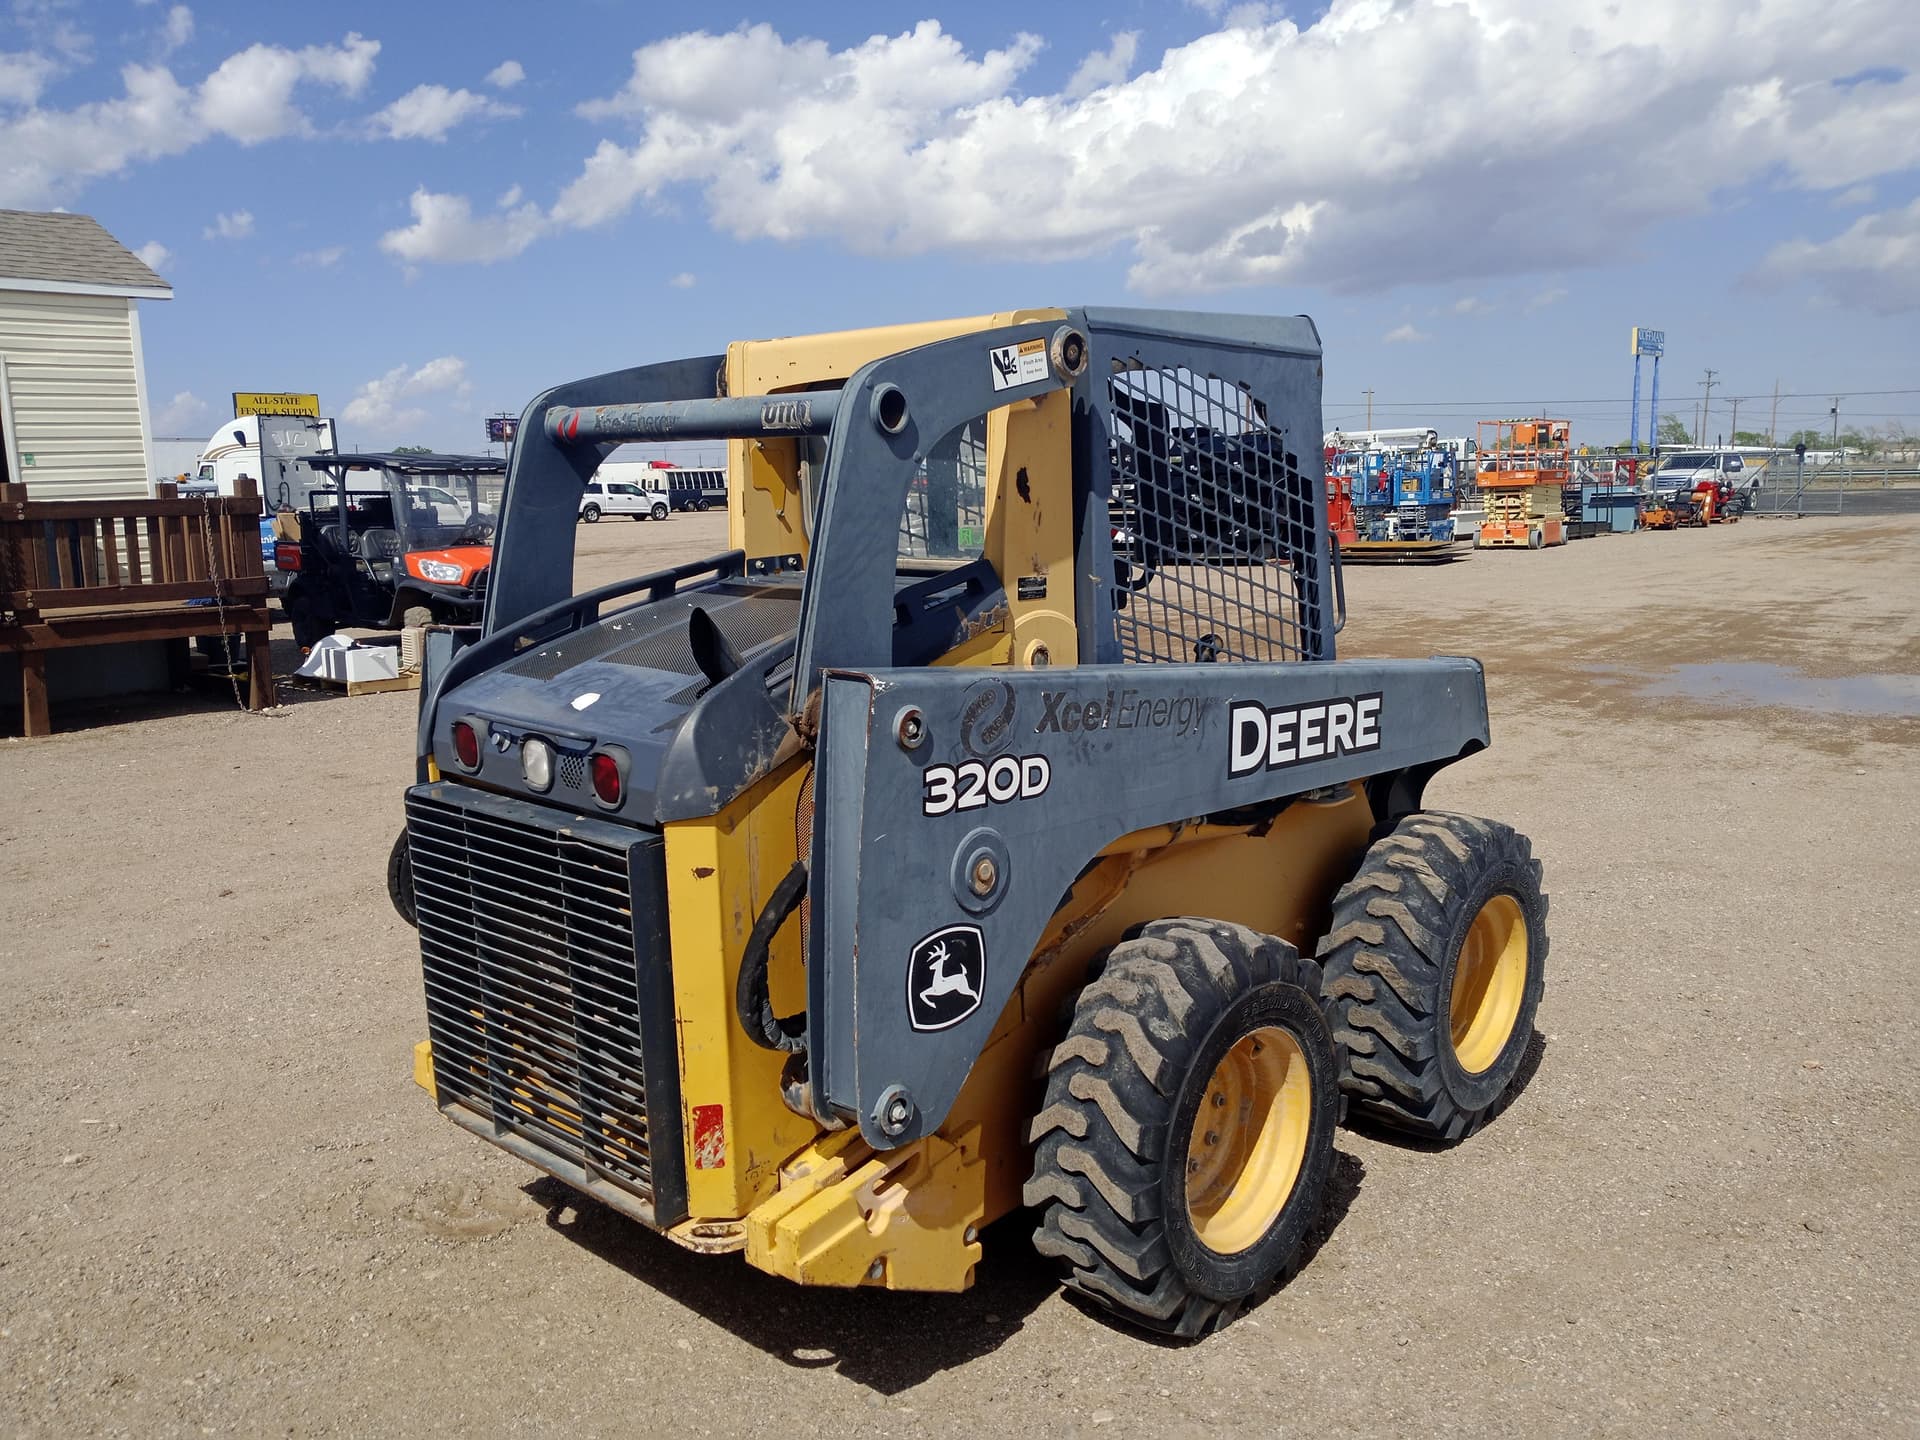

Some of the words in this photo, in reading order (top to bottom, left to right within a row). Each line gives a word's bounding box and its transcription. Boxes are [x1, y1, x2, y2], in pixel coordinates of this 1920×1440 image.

[240, 407, 270, 416] FENCE
[281, 408, 314, 416] SUPPLY
[253, 396, 301, 405] ALL-STATE
[1034, 690, 1116, 734] Xcel
[1116, 689, 1207, 737] Energy
[1229, 693, 1382, 778] DEERE
[924, 755, 1051, 816] 320D
